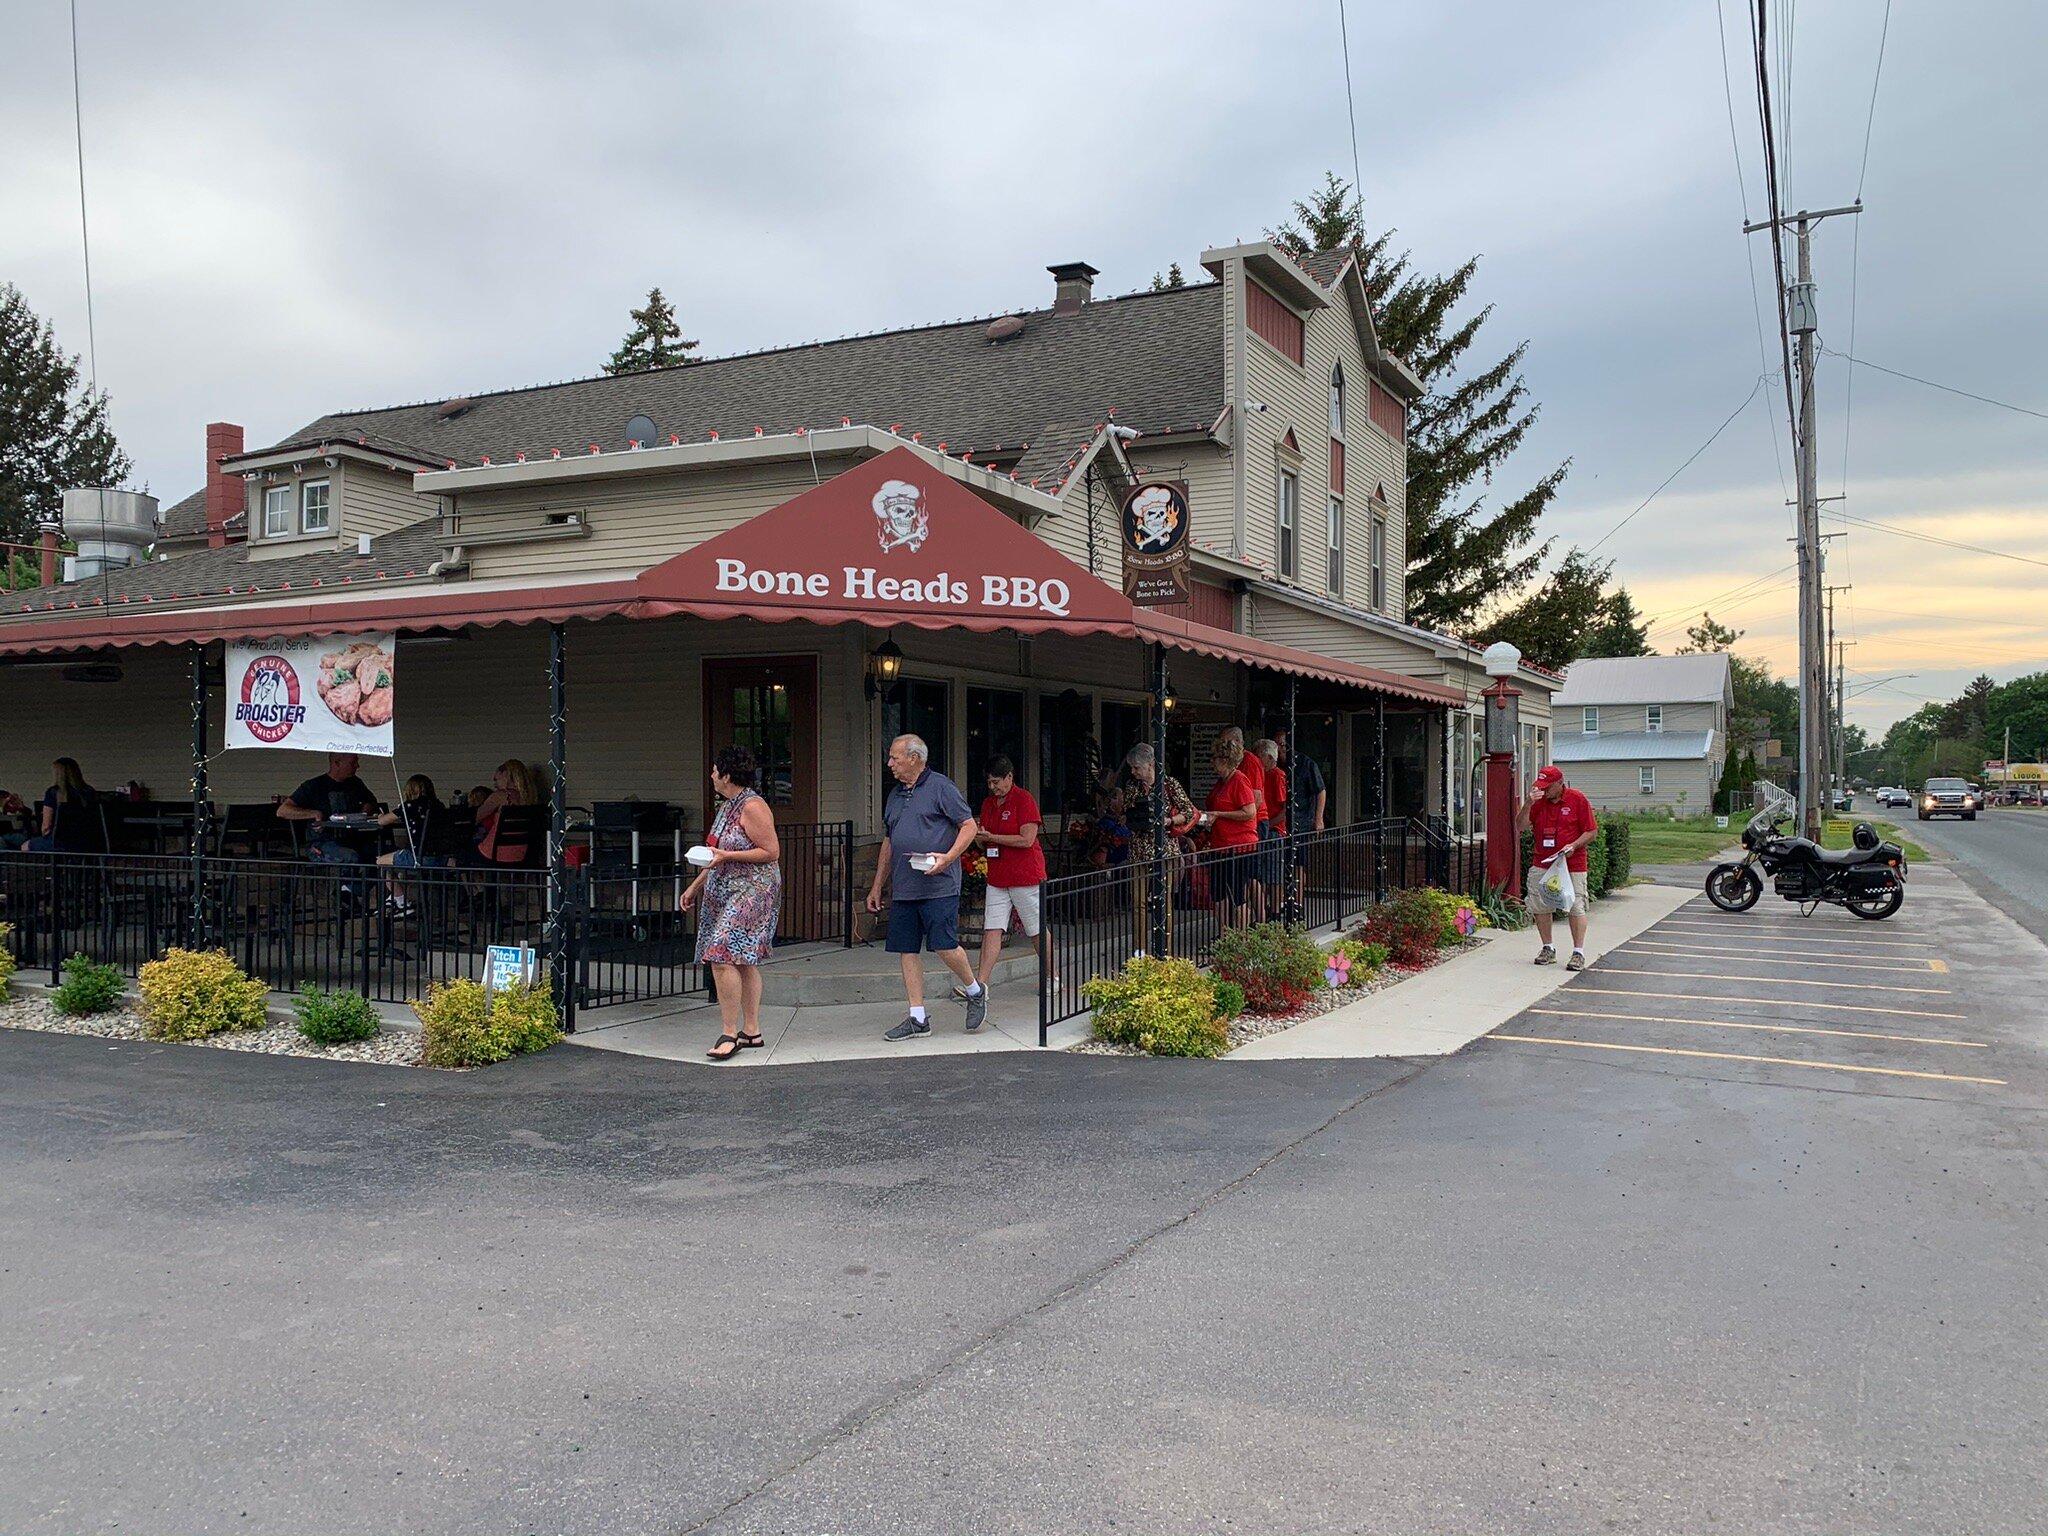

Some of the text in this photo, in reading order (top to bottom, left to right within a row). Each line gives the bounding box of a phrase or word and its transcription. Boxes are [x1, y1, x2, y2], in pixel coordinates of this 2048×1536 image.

[715, 558, 1070, 616] Bone Heads BBQ
[1138, 580, 1155, 588] We've
[248, 639, 284, 653] Proudly
[286, 639, 309, 650] Serve
[250, 660, 292, 678] GENUINE
[236, 703, 306, 723] BROASTER
[252, 723, 288, 738] CHICKEN
[327, 742, 354, 751] Chicken
